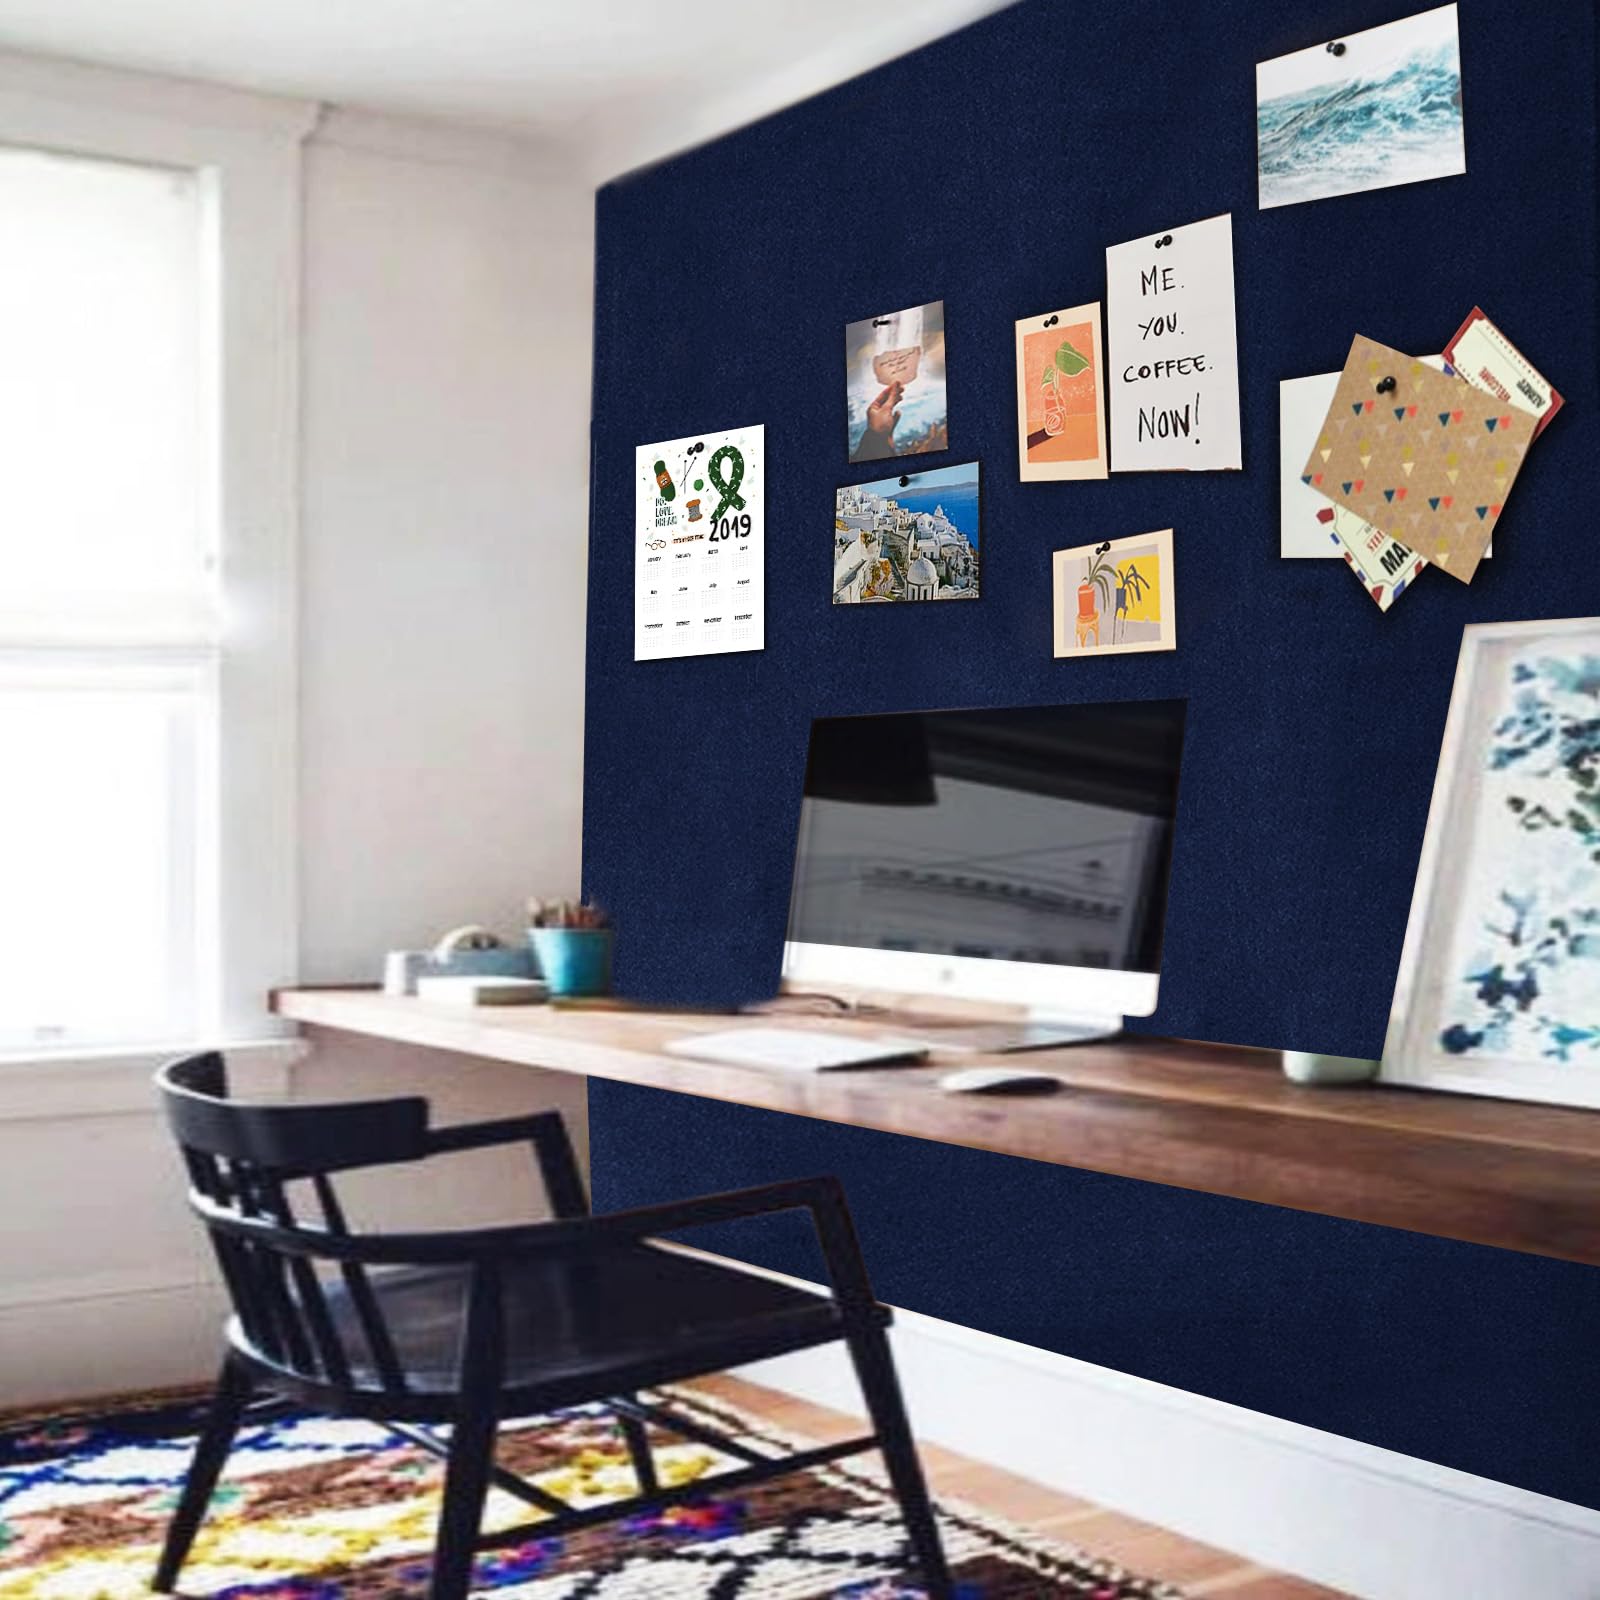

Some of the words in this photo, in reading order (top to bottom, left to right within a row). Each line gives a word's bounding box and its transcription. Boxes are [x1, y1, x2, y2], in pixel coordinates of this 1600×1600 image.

[1140, 264, 1185, 297] ME.
[1137, 311, 1185, 341] YOU.
[1122, 354, 1213, 384] COFFEE.
[1139, 392, 1201, 445] NOW!
[709, 514, 752, 543] 2019
